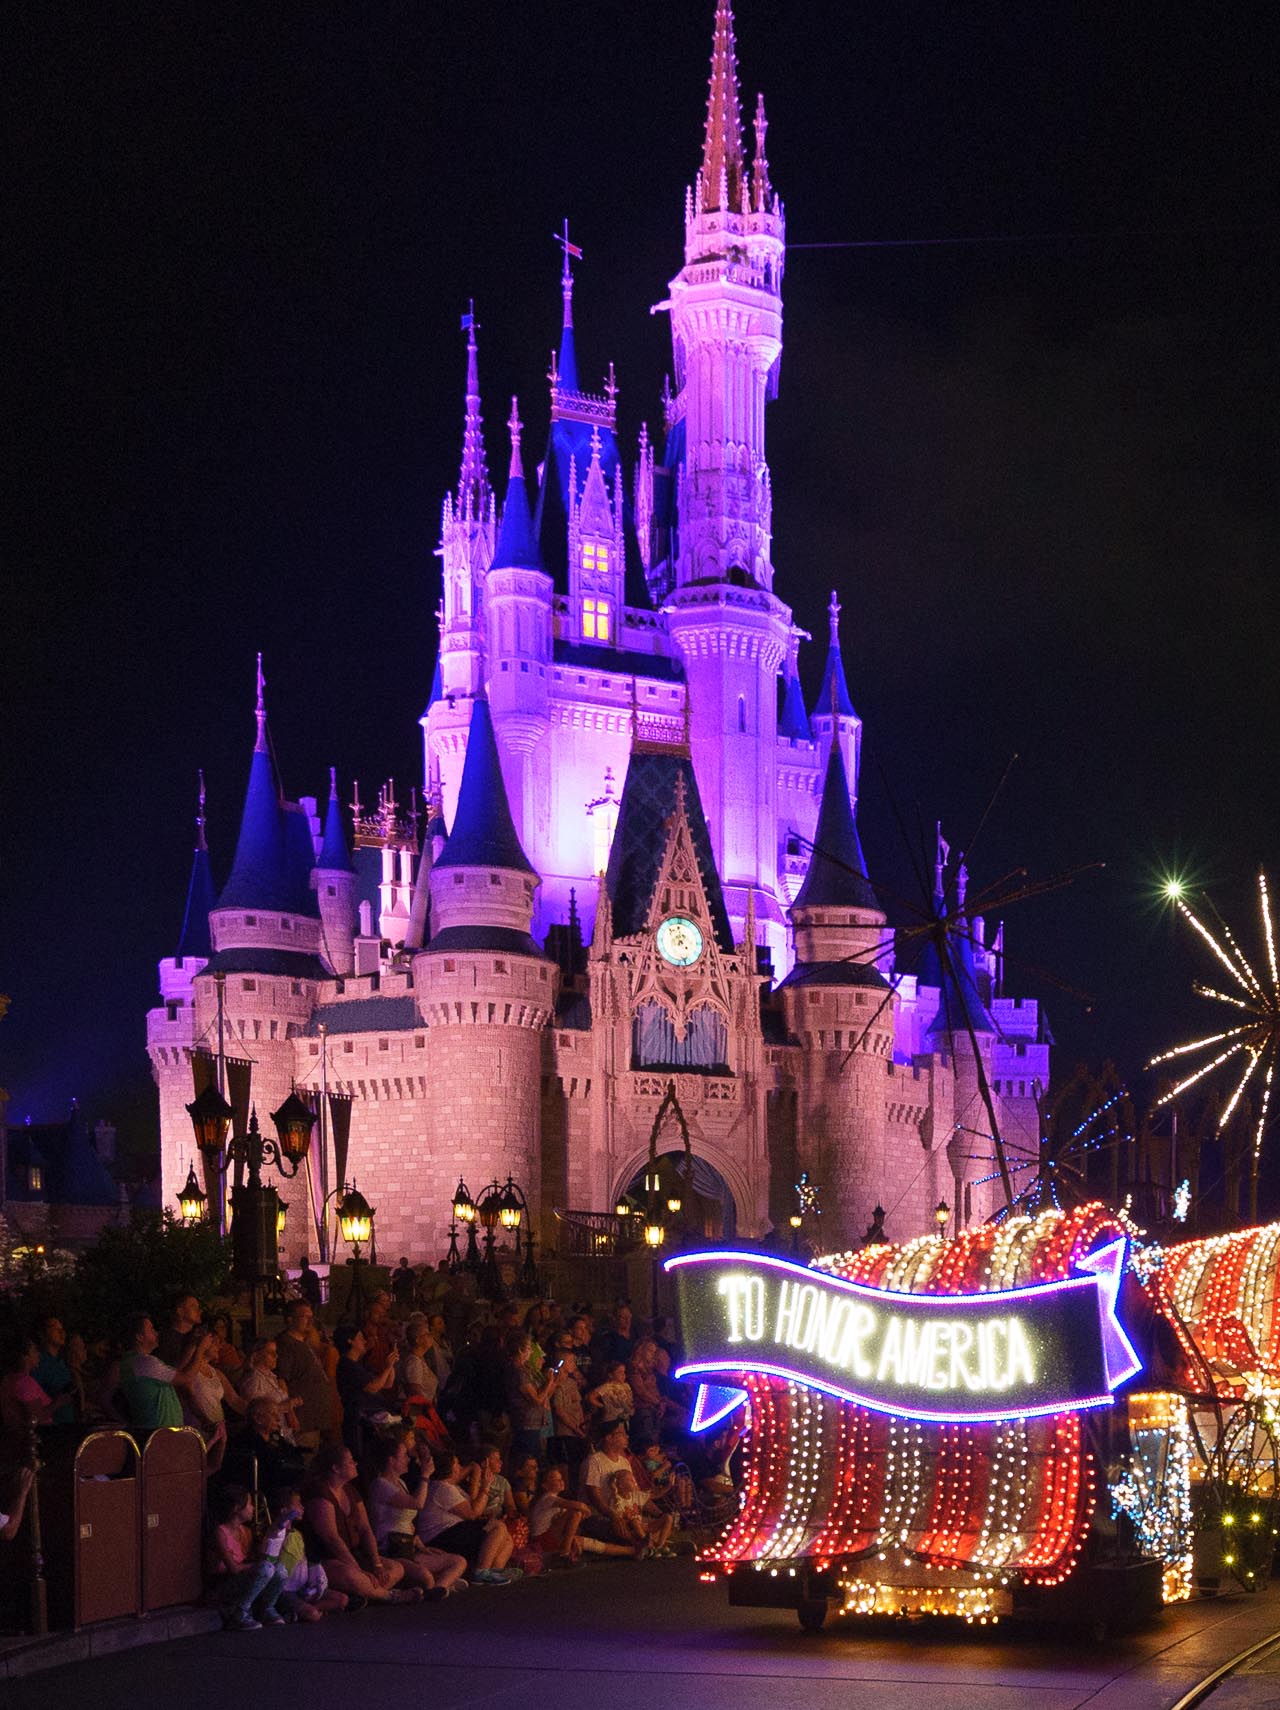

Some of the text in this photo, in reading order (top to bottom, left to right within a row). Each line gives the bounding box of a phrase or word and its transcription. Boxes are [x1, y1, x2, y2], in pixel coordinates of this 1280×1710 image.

[718, 1274, 1034, 1392] TO HONOR AMERICA
